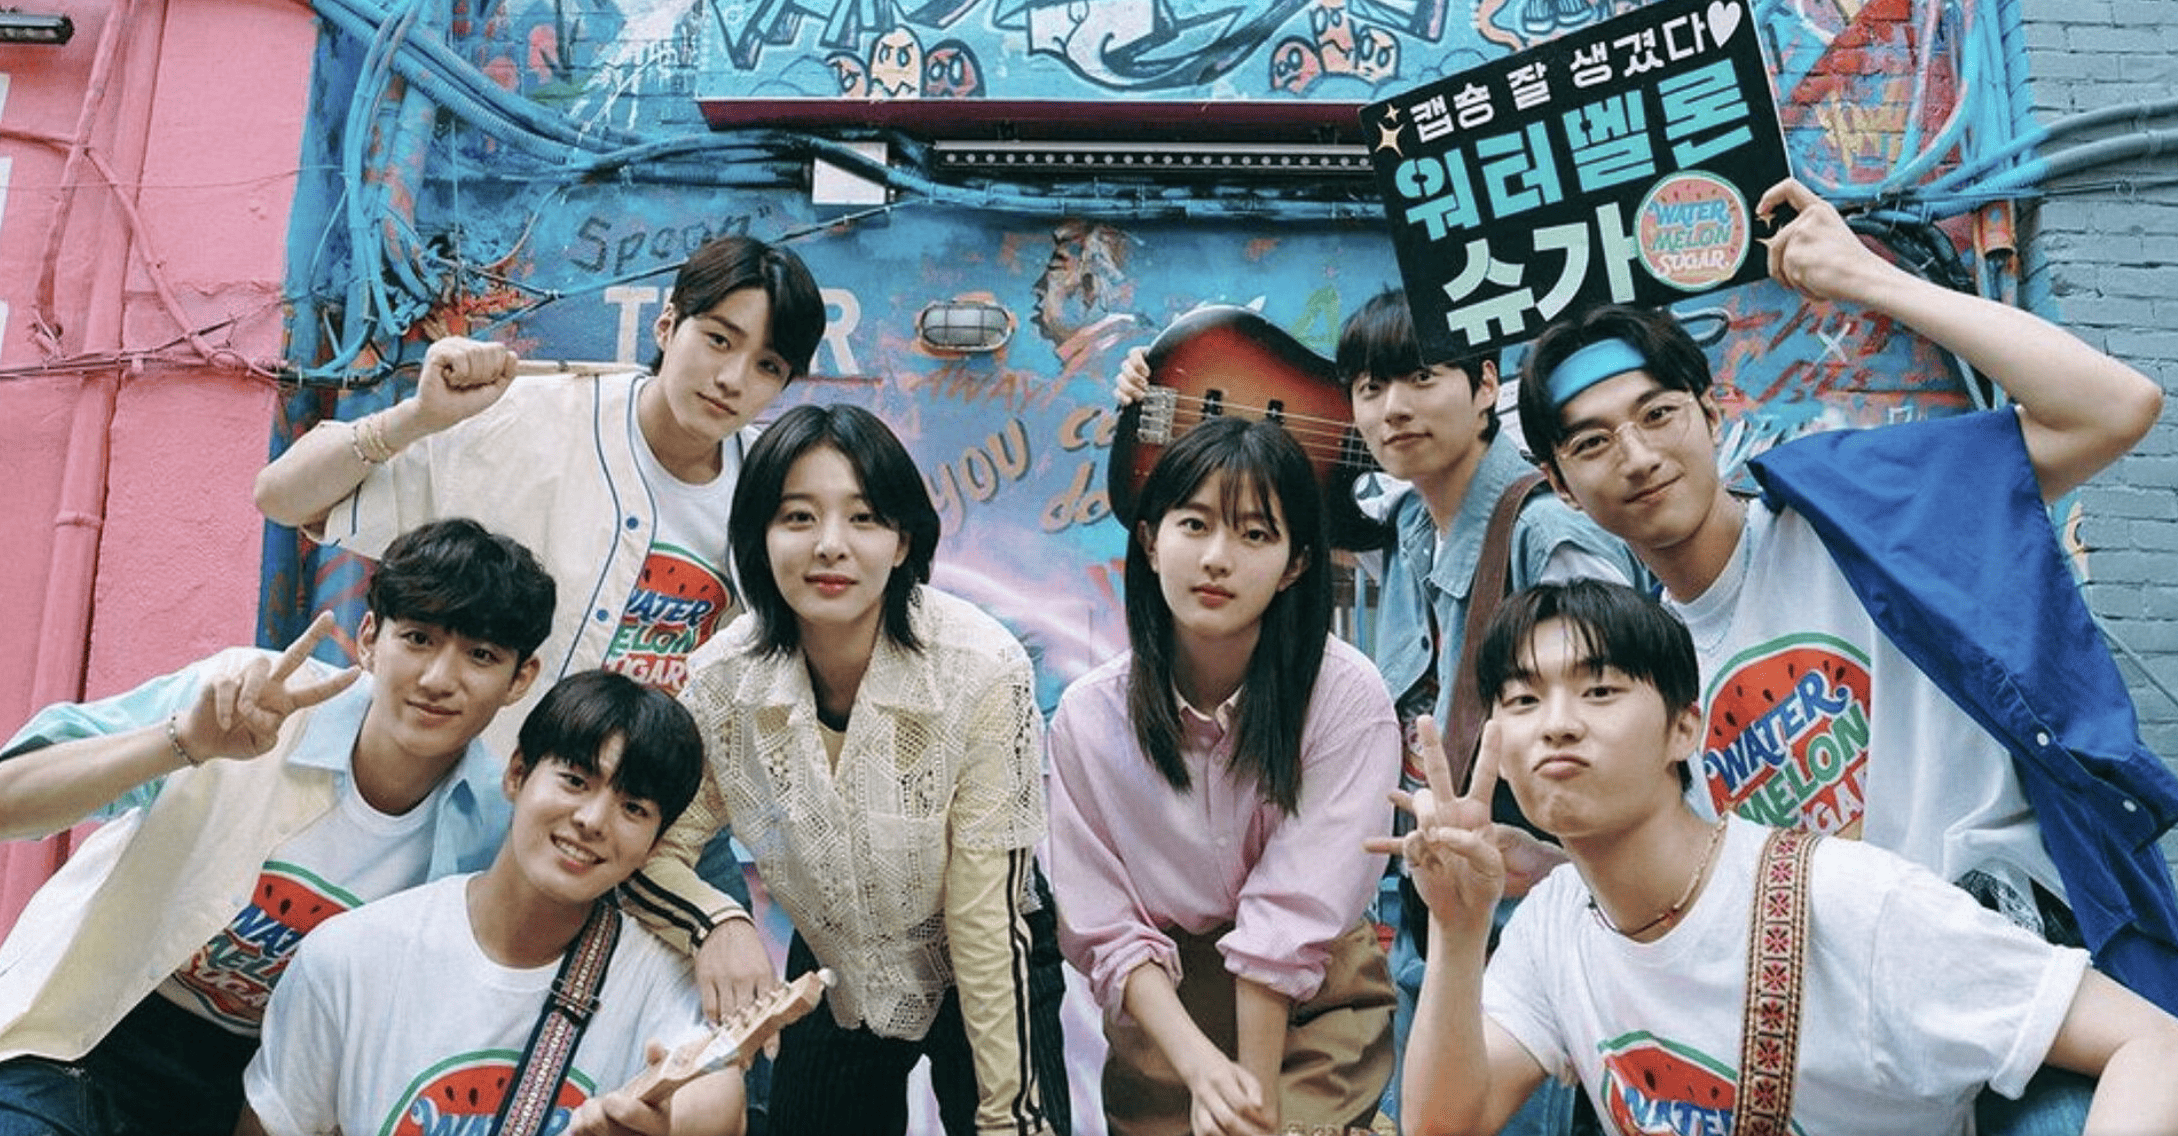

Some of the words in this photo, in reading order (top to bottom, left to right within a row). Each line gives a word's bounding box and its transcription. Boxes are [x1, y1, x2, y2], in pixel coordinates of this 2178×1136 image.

[1505, 61, 1552, 111] 잘
[1569, 12, 1706, 88] 생겼다
[1647, 198, 1731, 228] WATER
[1652, 223, 1731, 252] MELON
[1442, 201, 1638, 347] 슈가
[623, 586, 714, 627] ATER
[606, 624, 696, 658] ELON
[1702, 671, 1849, 792] WATER
